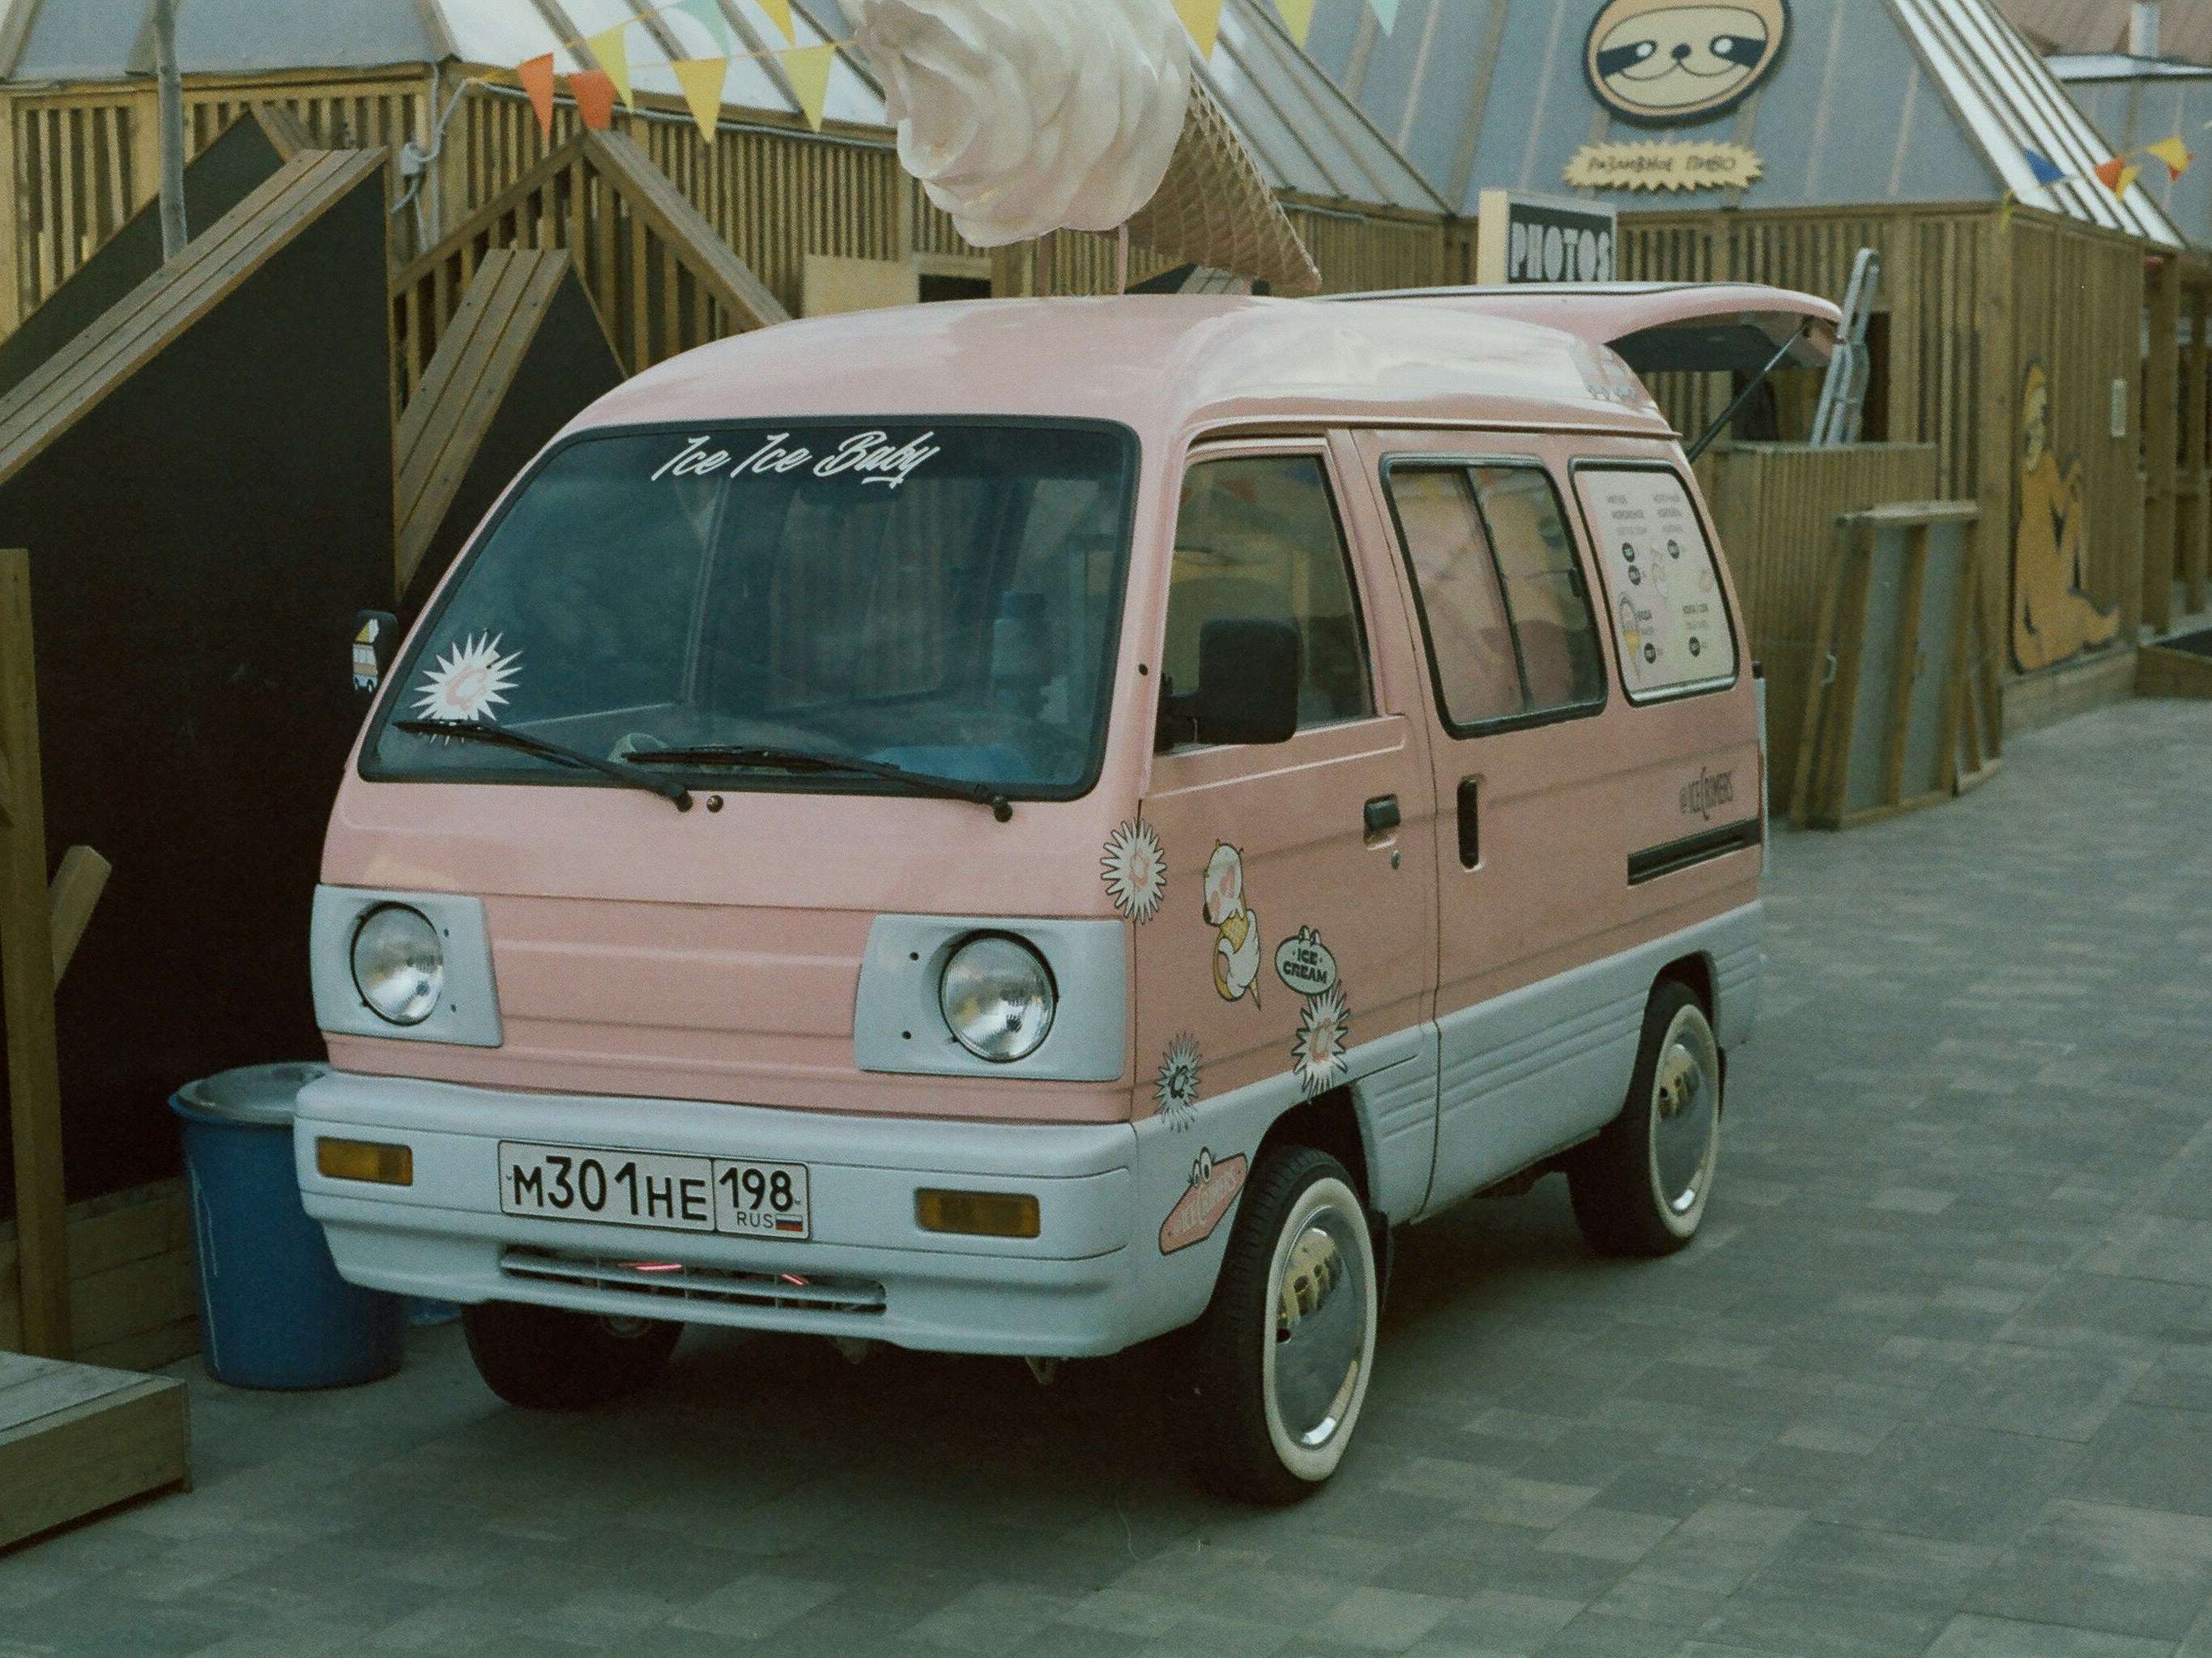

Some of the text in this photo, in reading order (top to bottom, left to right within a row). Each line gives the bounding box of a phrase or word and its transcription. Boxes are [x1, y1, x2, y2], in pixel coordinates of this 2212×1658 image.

[1511, 223, 1610, 281] PHOTOS
[650, 430, 940, 489] Ice Ice Baby
[1283, 961, 1328, 984] CREAM
[1298, 948, 1318, 966] ICE
[718, 1166, 794, 1213] 198
[735, 1211, 774, 1229] RUS
